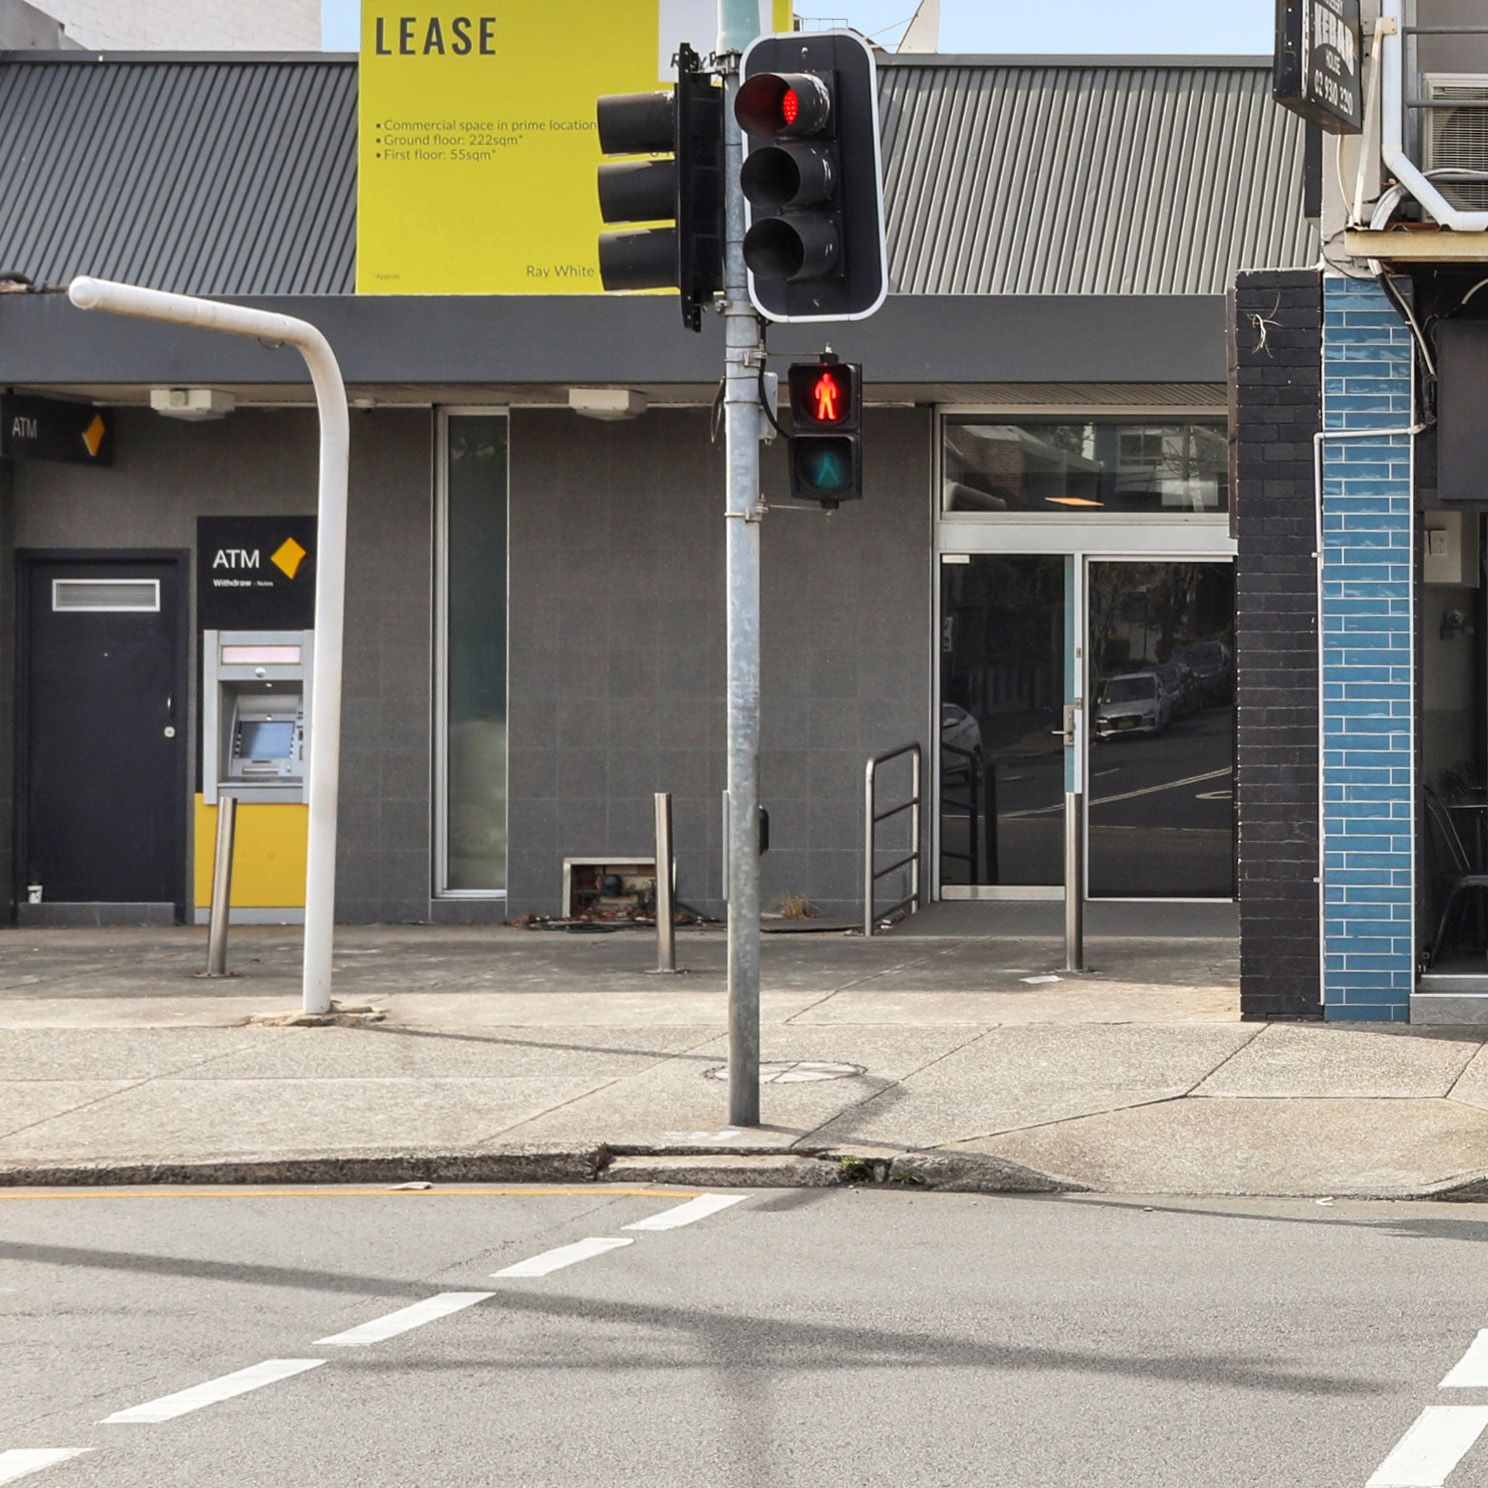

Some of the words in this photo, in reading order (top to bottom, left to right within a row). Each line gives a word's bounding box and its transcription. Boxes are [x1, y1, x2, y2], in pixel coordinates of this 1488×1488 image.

[375, 16, 497, 56] LEASE
[383, 119, 456, 131] Commercial
[459, 121, 494, 132] space
[497, 120, 508, 130] in
[511, 120, 546, 132] prime
[549, 119, 597, 130] location
[383, 134, 430, 145] Ground
[433, 134, 465, 145] floor:
[384, 149, 410, 160] First
[414, 149, 447, 160] floor:
[525, 265, 550, 279] Ray
[555, 265, 595, 278] White
[11, 416, 37, 440] ATM
[212, 549, 260, 569] ATM
[212, 579, 252, 587] Withdraw
